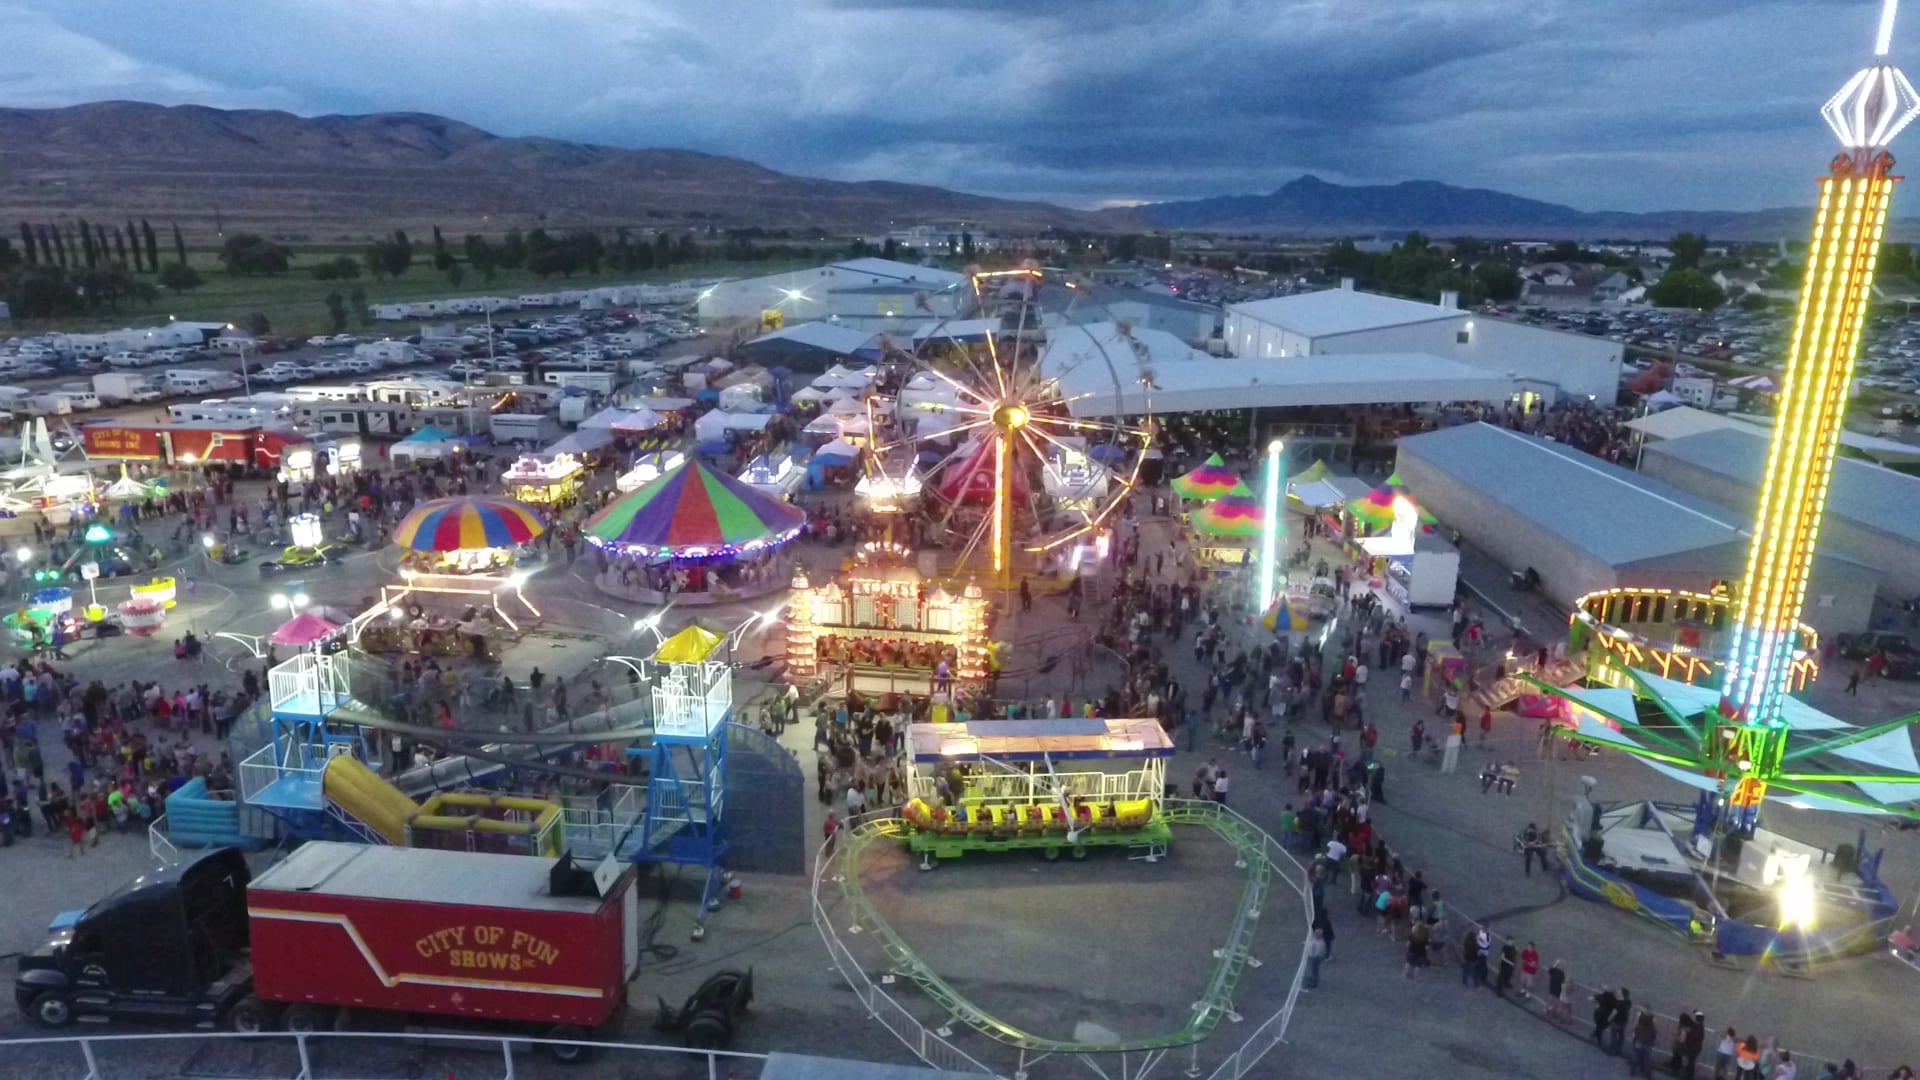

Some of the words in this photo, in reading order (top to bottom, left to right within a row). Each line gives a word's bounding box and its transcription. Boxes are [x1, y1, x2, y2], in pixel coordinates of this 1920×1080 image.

[415, 925, 466, 958] CITY
[474, 925, 504, 945] OF
[511, 930, 560, 966] FUN
[449, 949, 522, 971] SHOWS
